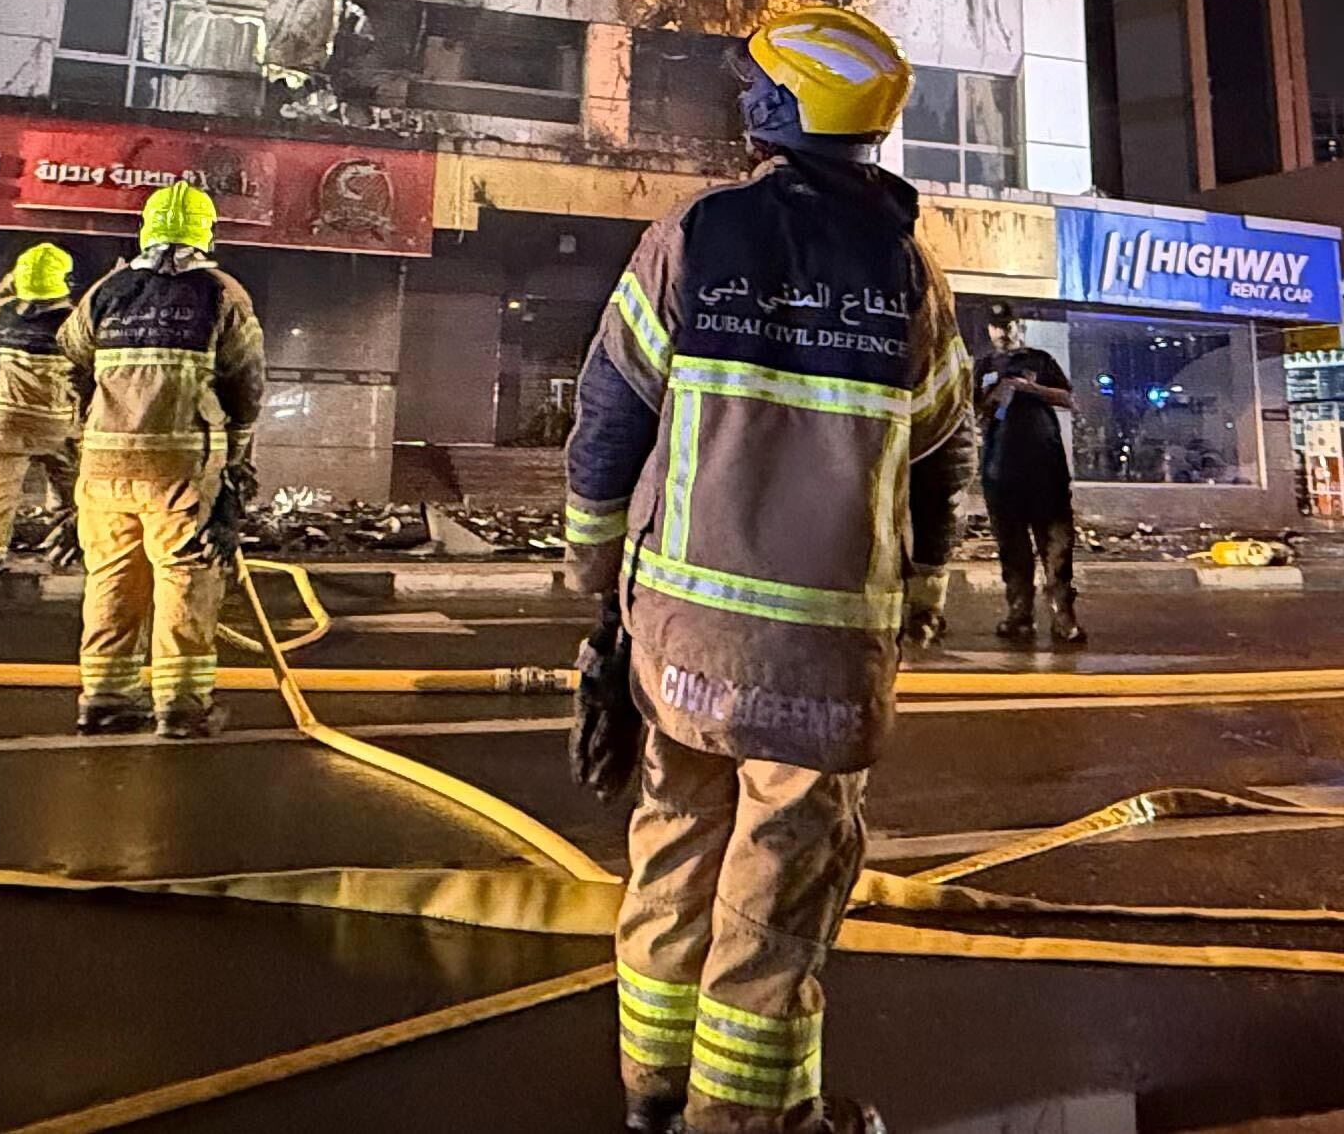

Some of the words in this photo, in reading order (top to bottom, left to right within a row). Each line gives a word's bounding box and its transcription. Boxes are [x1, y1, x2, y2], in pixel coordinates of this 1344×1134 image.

[1151, 239, 1310, 285] HIGHWAY
[698, 277, 749, 306] دبي
[757, 282, 831, 312] المدني
[839, 285, 912, 326] لدفاع
[1229, 281, 1268, 299] RENT
[1268, 284, 1282, 300] A
[1283, 284, 1314, 304] CAR
[696, 313, 762, 336] DUBAI
[764, 320, 815, 347] CIVIL
[816, 330, 911, 358] DEFENCE
